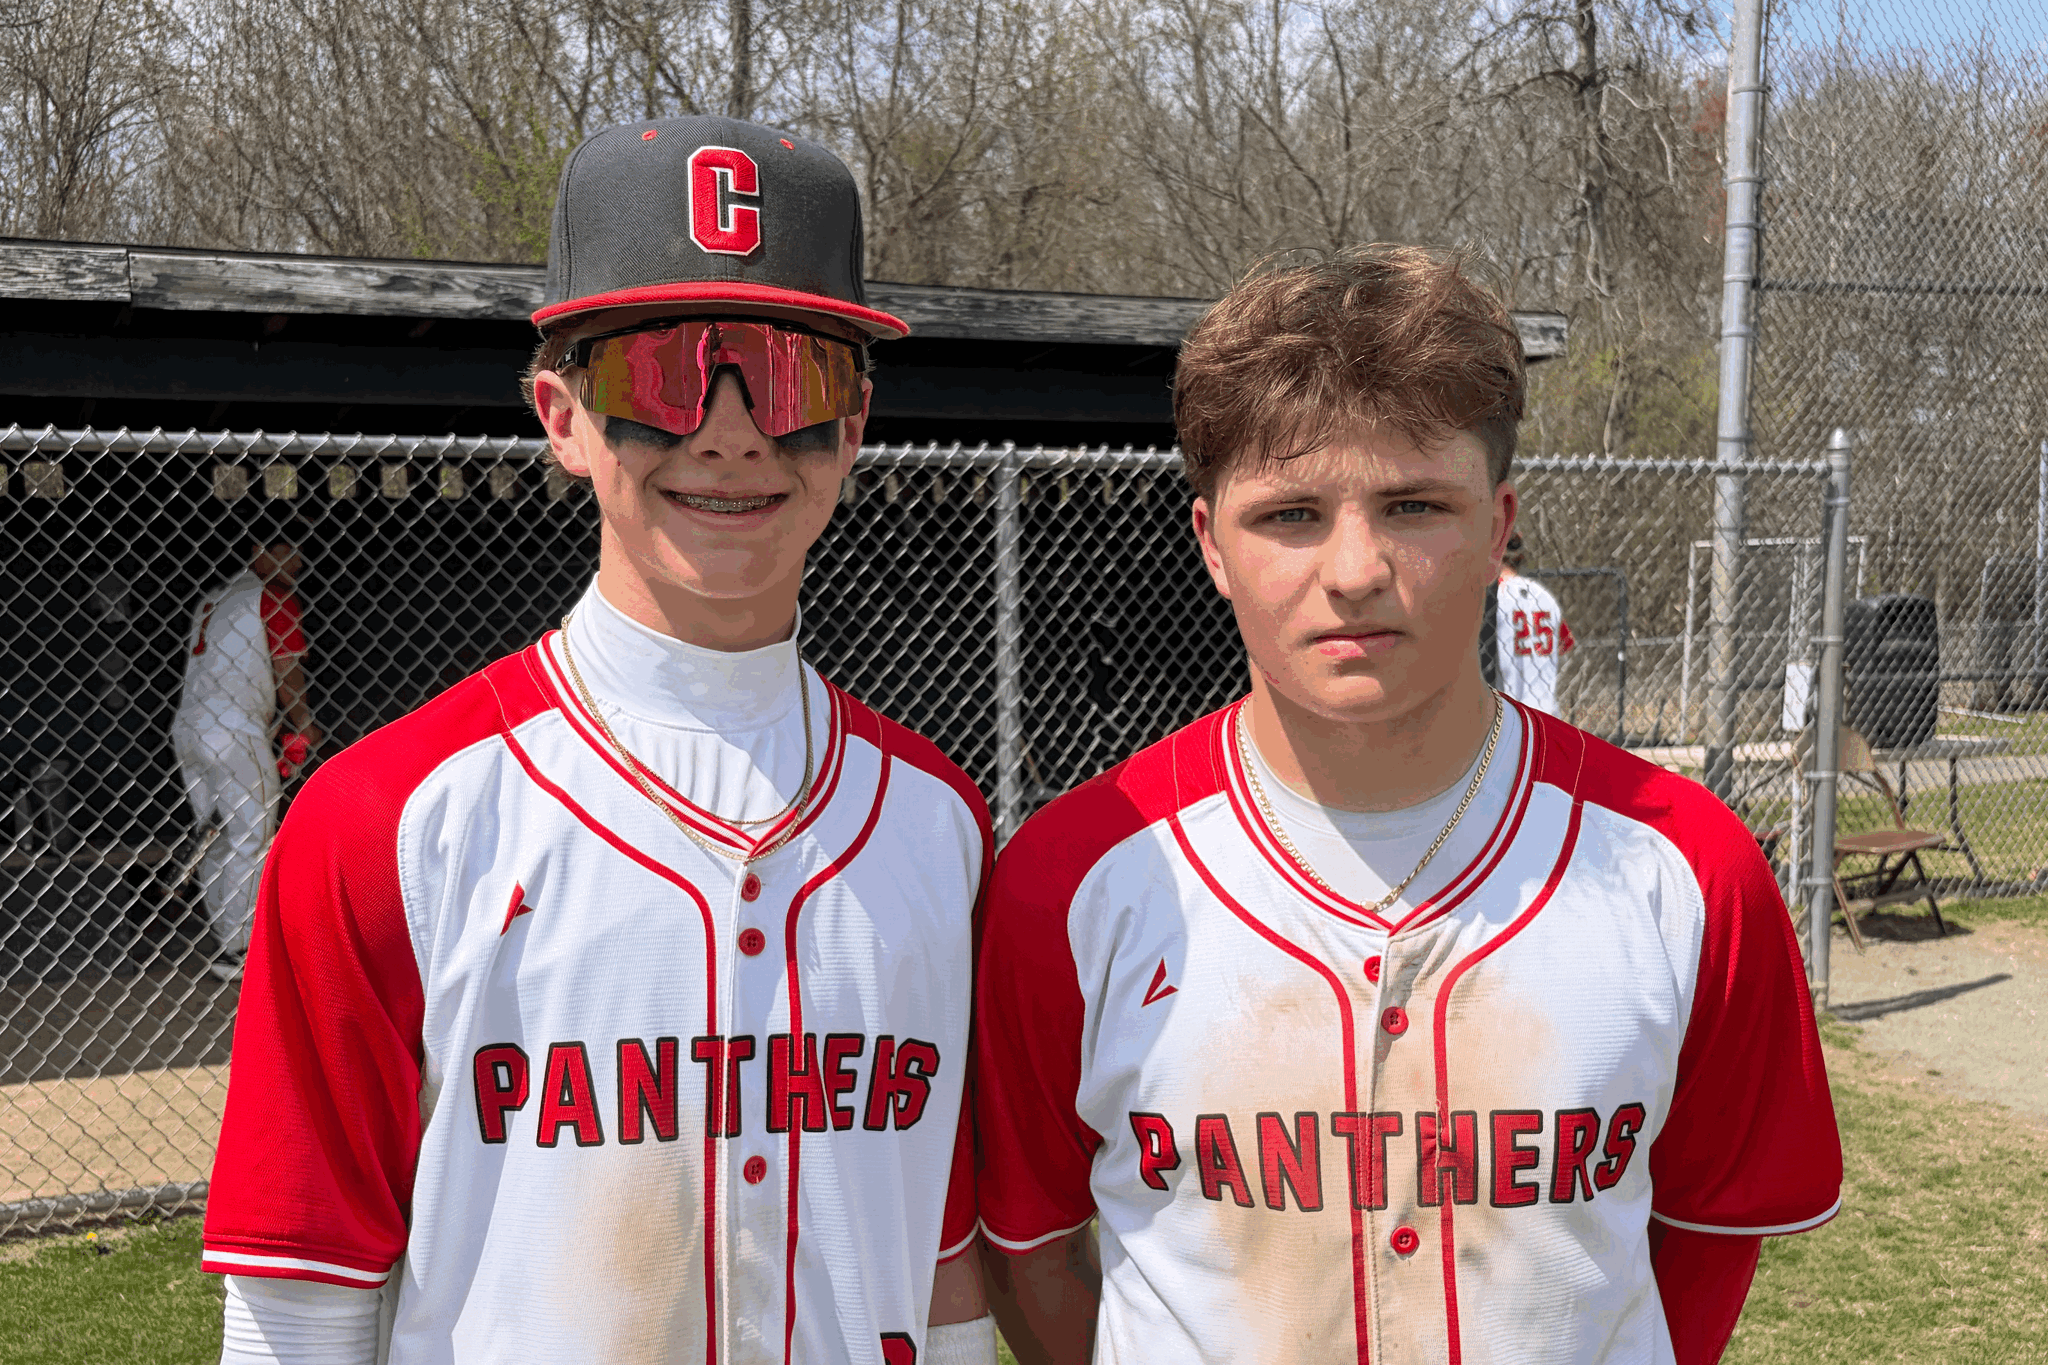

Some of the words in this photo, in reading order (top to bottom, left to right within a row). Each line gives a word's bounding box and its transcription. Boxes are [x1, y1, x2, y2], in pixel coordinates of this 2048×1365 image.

[687, 146, 761, 256] C
[1512, 610, 1554, 656] 25
[1129, 1102, 1647, 1212] PANTHERS
